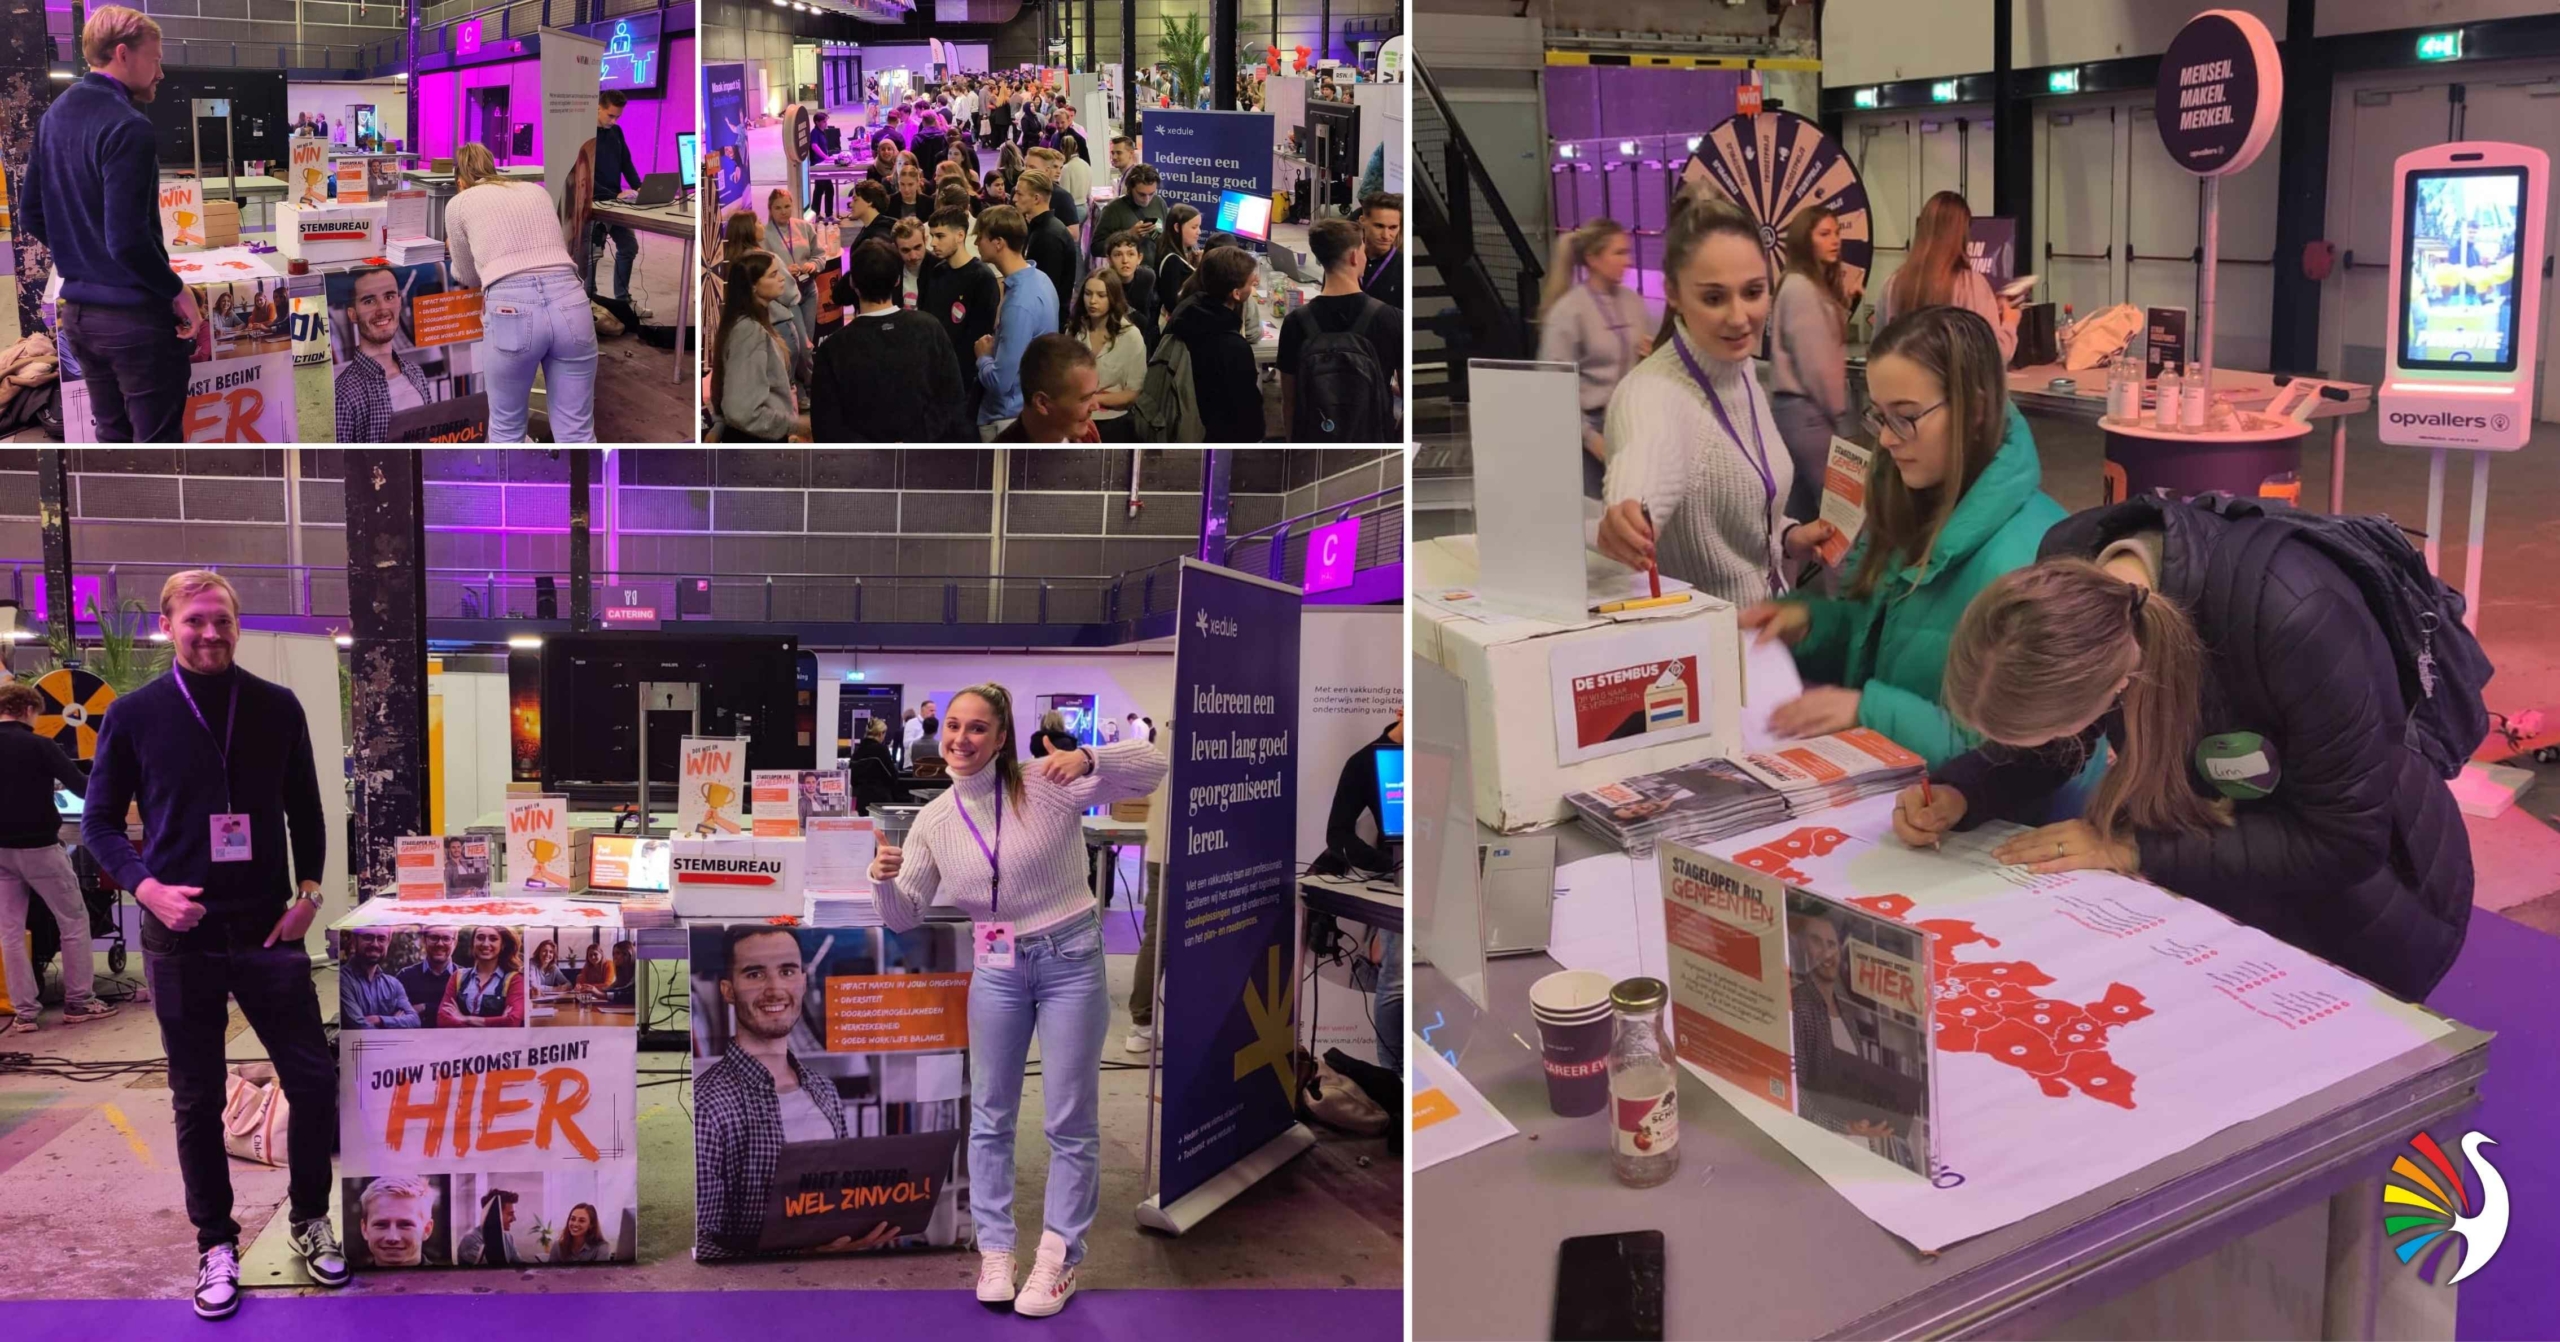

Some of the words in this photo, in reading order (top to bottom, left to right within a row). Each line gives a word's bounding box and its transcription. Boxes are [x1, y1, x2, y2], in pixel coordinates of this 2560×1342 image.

[464, 26, 473, 44] C
[2180, 59, 2234, 87] MENSEN.
[1738, 90, 1760, 106] win
[2180, 83, 2226, 109] MAKEN.
[2180, 105, 2234, 132] MERKEN.
[1168, 126, 1194, 136] xedule
[293, 147, 321, 165] WIN
[1155, 152, 1212, 167] Iedereen
[1214, 158, 1240, 170] een
[1191, 171, 1220, 188] lang
[1223, 176, 1257, 190] goed
[159, 189, 192, 208] WIN
[300, 220, 370, 233] STEMBUREAU
[292, 351, 325, 364] CTION
[216, 364, 262, 390] BEGINT
[183, 388, 267, 443] ER
[2389, 412, 2486, 428] opvallers
[1322, 534, 1338, 567] C
[608, 609, 654, 619] CATERING
[1210, 617, 1238, 638] xedule
[1575, 678, 1595, 692] DE
[1597, 664, 1660, 688] STEMBUS
[1193, 684, 1252, 714] Iedereen
[1254, 694, 1274, 714] een
[1314, 696, 1352, 704] onderwijs
[1372, 697, 1404, 706] logistie
[1350, 686, 1390, 696] vakkundig
[1312, 706, 1370, 714] ondersteuning
[1191, 730, 1228, 761] leven
[1230, 730, 1257, 766] lang
[1258, 730, 1288, 764] goed
[686, 750, 732, 776] WIN
[1188, 771, 1282, 817] georganiseerd
[510, 808, 554, 834] WIN
[1188, 826, 1228, 856] leren.
[673, 856, 782, 874] STEMBUREAU
[1672, 857, 1740, 896] STAGELOPEN
[1744, 884, 1762, 903] BIJ
[1672, 878, 1774, 927] GEMEENTEN
[840, 982, 866, 990] IMPACT
[868, 980, 894, 990] MAKEN
[896, 980, 906, 988] IN
[907, 980, 926, 988] JOUW
[929, 979, 967, 988] OMGEVING
[1860, 960, 1918, 1013] HIER
[840, 995, 884, 1004] DIVERSITEIT
[840, 1022, 900, 1032] WERKZEKERHEID
[841, 1037, 867, 1045] GOEDE
[910, 1034, 945, 1043] BALANCE
[371, 1064, 424, 1090] JOUW
[430, 1050, 522, 1081] TOEKOMST
[527, 1040, 590, 1066] BEGINT
[1543, 1059, 1588, 1076] CAREER
[385, 1066, 600, 1163] HIER
[799, 1170, 838, 1190] NIET
[842, 1168, 908, 1186] STOFFIG
[786, 1194, 835, 1218] WEL
[840, 1177, 930, 1209] ZINVOL!
